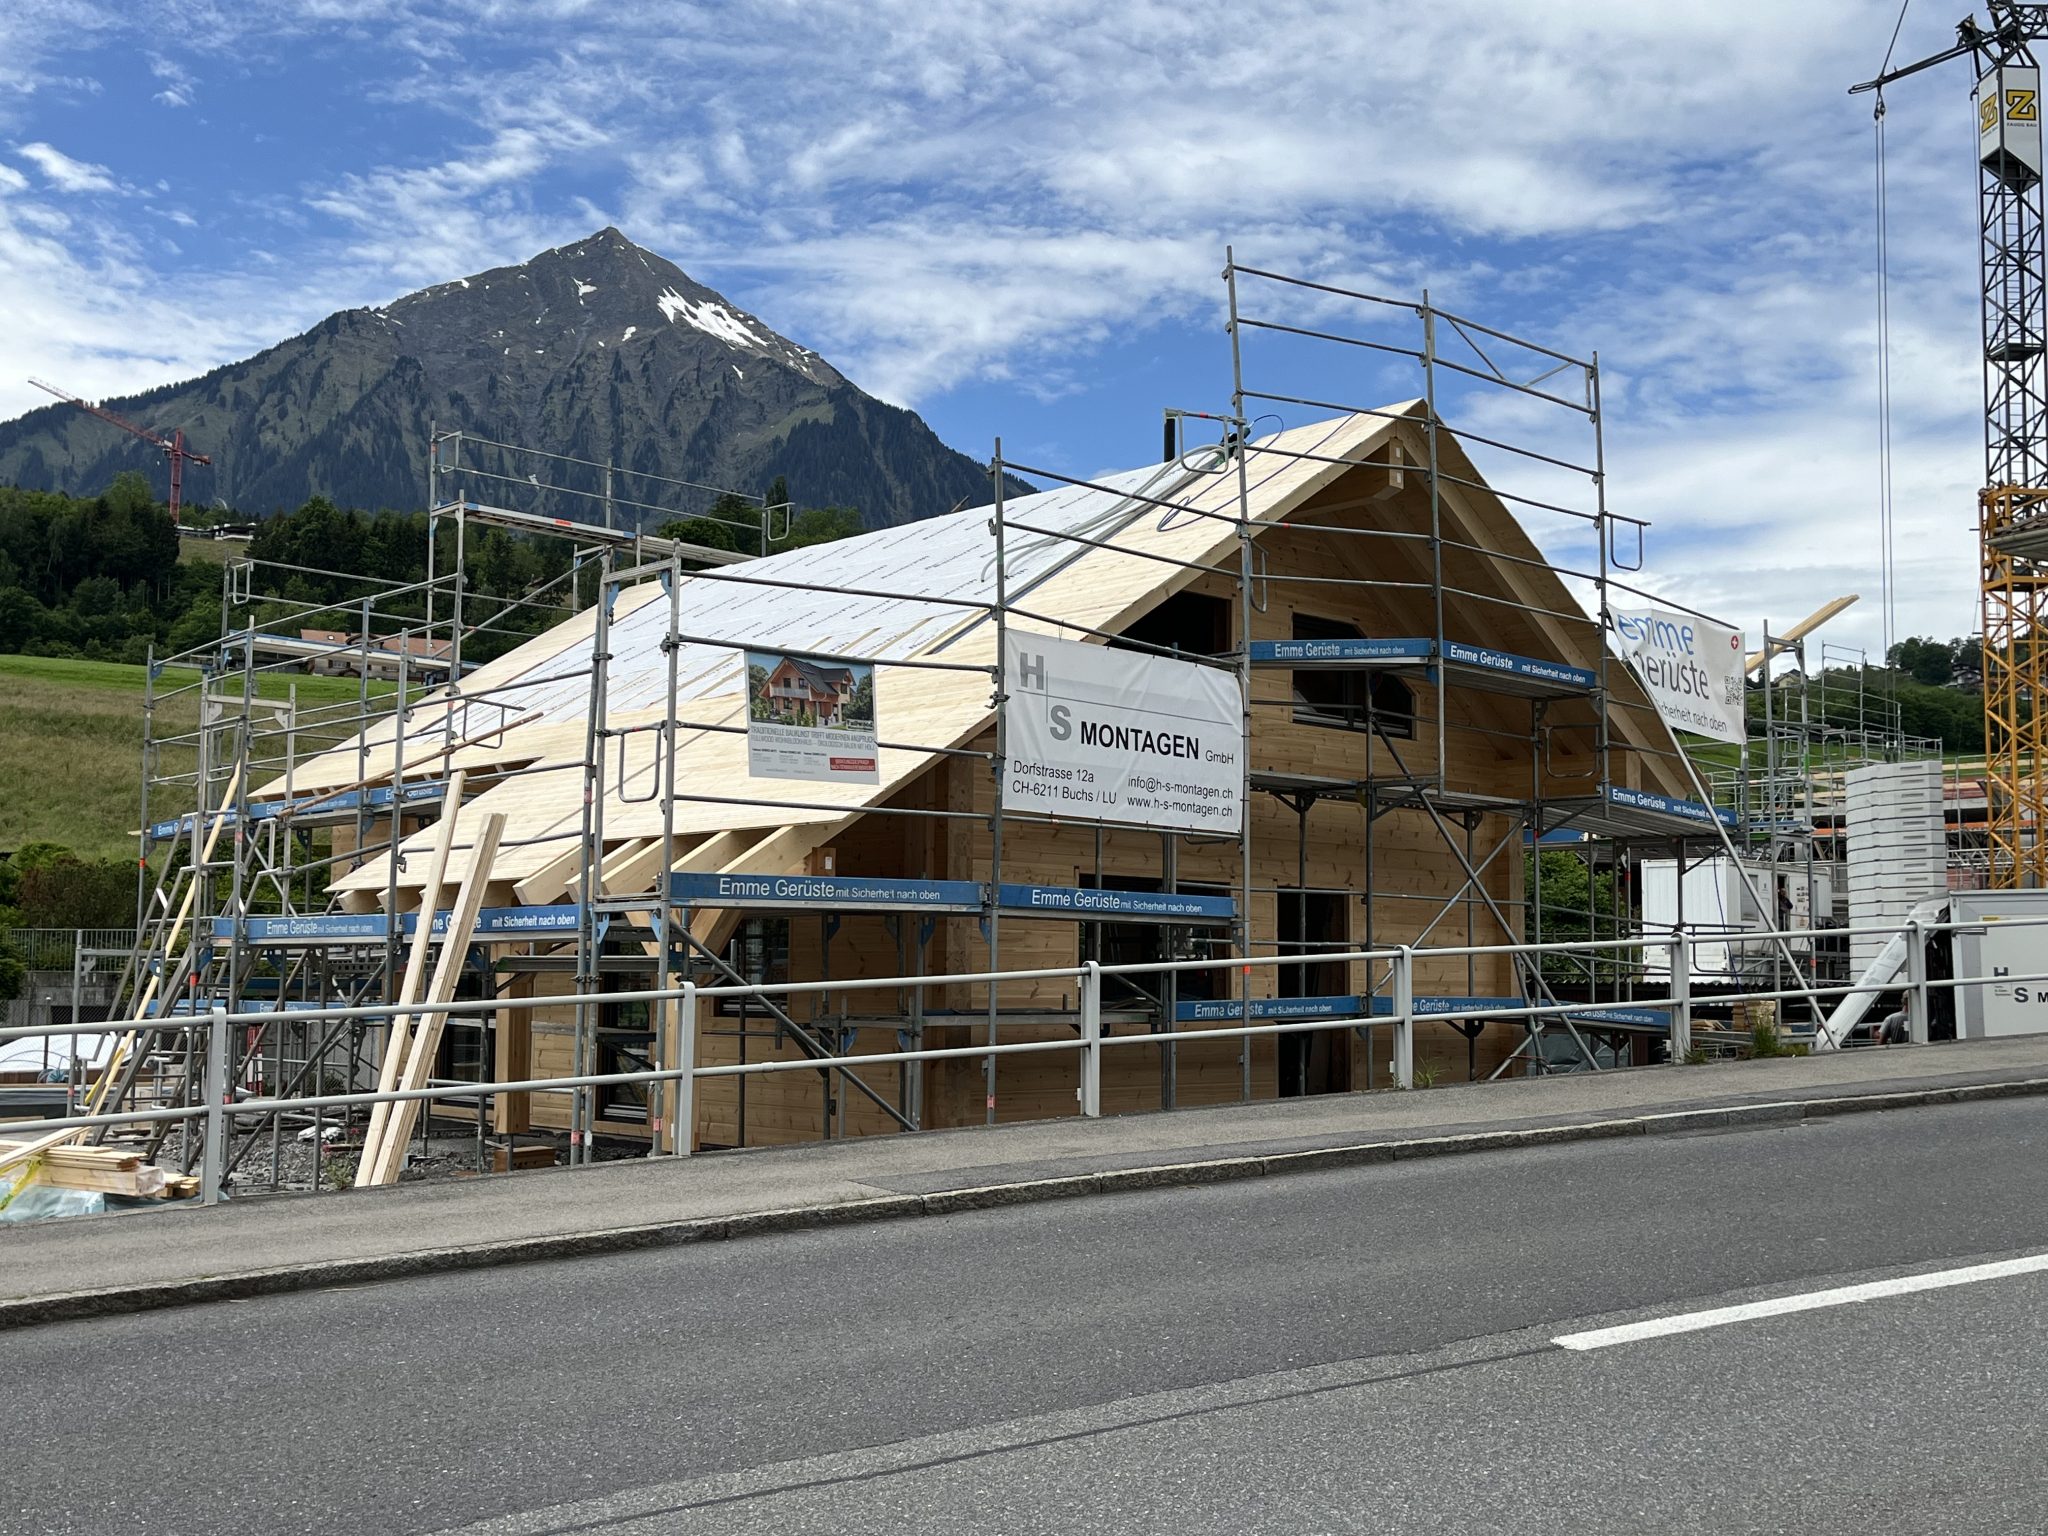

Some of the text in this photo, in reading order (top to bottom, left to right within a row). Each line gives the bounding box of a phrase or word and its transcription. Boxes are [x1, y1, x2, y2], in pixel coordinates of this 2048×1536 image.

[1981, 92, 1998, 133] Z
[2006, 89, 2036, 120] Z
[1617, 614, 1694, 656] emme
[1275, 644, 1303, 657] Emme
[1306, 643, 1340, 657] Gerüste
[1354, 647, 1378, 655] Sicherheit
[1380, 646, 1391, 654] nach
[1019, 652, 1045, 690] H
[1450, 645, 1585, 683] Emme Gerüste mit Sicherheit nach oben
[1693, 712, 1708, 728] nach
[1710, 717, 1727, 733] oben
[1050, 705, 1234, 765] S MONTAGEN GmbH
[1014, 760, 1094, 783] Dorfstrasse 12a
[1012, 780, 1058, 798] CH-6211
[1062, 788, 1093, 802] Buchs
[1103, 791, 1117, 805] LU
[1128, 776, 1233, 800] info@h-s-montagen.ch
[1127, 796, 1233, 818] www.h-s-montagen.ch
[1612, 789, 1635, 804] Emme
[1638, 794, 1666, 810] Gerüste
[1682, 806, 1706, 817] Sicherheit
[719, 878, 770, 896] Emme
[775, 879, 835, 898] Gerüste
[836, 888, 850, 897] mit
[897, 890, 917, 899] nach
[920, 890, 940, 900] oben
[1032, 889, 1202, 912] Emme Gerüste mit Sicherheit nach oben
[267, 921, 288, 935] Emme
[290, 920, 317, 935] Gerüste
[492, 917, 503, 927] mit
[504, 915, 537, 927] Sicherheit
[538, 916, 555, 925] nach
[558, 914, 575, 925] oben
[1420, 999, 1450, 1012] Gerüste
[2014, 987, 2029, 1003] S
[1195, 1004, 1224, 1017] Emme
[1228, 1003, 1263, 1016] Gerste
